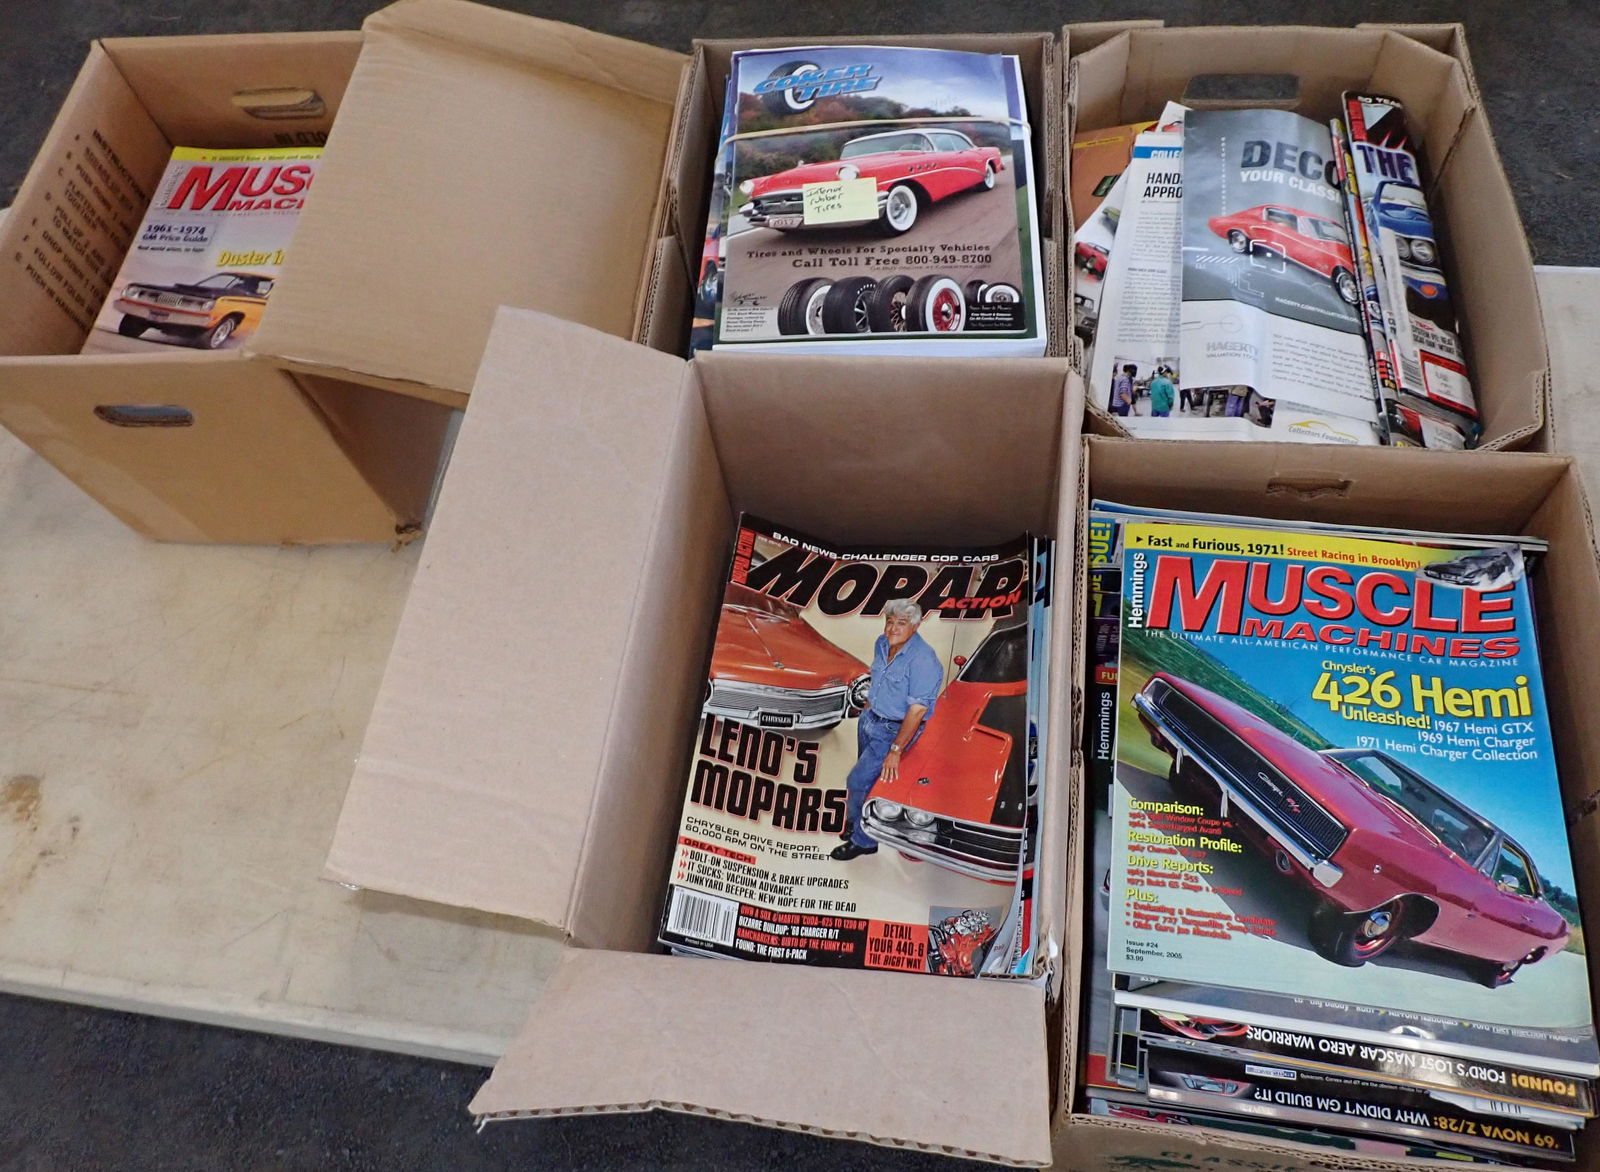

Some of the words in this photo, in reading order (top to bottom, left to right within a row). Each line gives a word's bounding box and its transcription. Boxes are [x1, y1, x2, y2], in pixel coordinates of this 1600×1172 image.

[753, 64, 873, 93] COKER
[798, 77, 882, 101] TIRE
[1151, 150, 1183, 158] COLLE
[1146, 172, 1182, 185] HAND
[1240, 169, 1285, 184] YOUR
[166, 165, 315, 211] MUS
[814, 203, 842, 213] Tires
[183, 235, 208, 243] Guide
[216, 251, 270, 267] Duster
[747, 250, 777, 258] Tires
[781, 248, 803, 256] and
[807, 246, 851, 255] Wheels
[856, 246, 876, 254] For
[880, 245, 935, 255] Specialty
[940, 243, 991, 252] Vehicles
[792, 258, 823, 268] Call
[829, 256, 859, 267] Toll
[865, 256, 900, 266] Free
[905, 254, 992, 265] 800-949-8700
[772, 531, 800, 547] BAD
[930, 554, 959, 562] COP
[963, 554, 999, 562] CARS
[1148, 535, 1173, 548] Fast
[1192, 538, 1245, 555] Furious,
[1247, 542, 1284, 555] 1971!
[1287, 547, 1318, 558] Street
[1321, 549, 1355, 563] Racing
[1358, 553, 1368, 563] in
[1371, 554, 1421, 570] Brooklyn!
[745, 545, 1026, 620] MOPAR
[1128, 552, 1148, 628] Hemmings
[938, 590, 1022, 609] ACTION
[1146, 555, 1516, 635] MUSCLE
[1144, 629, 1165, 638] THE
[1171, 631, 1224, 644] ULTIMATE
[1231, 637, 1318, 651] ALL-AMERICAN
[1325, 644, 1413, 662] PERFORMANCE
[1419, 655, 1441, 665] CAR
[1449, 657, 1519, 668] MAGAZINE
[1243, 618, 1521, 659] MACHINES
[1321, 660, 1377, 676] Chrysler's
[1312, 670, 1402, 711] 426
[1410, 675, 1533, 718] Hemi
[761, 714, 793, 724] CHRYSLER
[1098, 691, 1113, 760] Hemmings
[1341, 704, 1431, 730] Unleashed!
[1434, 720, 1460, 733] 1967
[1464, 722, 1498, 735] Hemi
[1501, 722, 1534, 734] GTX
[699, 712, 820, 784] LENO'S
[1356, 735, 1380, 748] 1971
[1385, 739, 1416, 754] Hemi
[1419, 744, 1468, 762] Charger
[1472, 749, 1538, 762] Collection
[1418, 731, 1444, 743] 1969
[1447, 735, 1480, 747] Hemi
[1484, 736, 1536, 751] Charger
[690, 759, 848, 834] MOPARS
[1128, 797, 1204, 816] Comparison:
[685, 824, 722, 840] 60,000
[725, 835, 747, 848] RPM
[750, 842, 765, 852] ON
[768, 848, 788, 858] THE
[791, 852, 831, 860] STREET
[686, 816, 740, 837] CHRYSLER
[743, 832, 773, 847] DRIVE
[776, 841, 820, 852] REPORT:
[1128, 829, 1196, 848] Restoration
[1200, 836, 1243, 853] Profile:
[684, 837, 720, 854] GREAT
[721, 850, 753, 864] TECH
[722, 859, 770, 881] SUSPENSION
[771, 872, 777, 882] &
[778, 873, 806, 887] BRAKE
[806, 876, 850, 889] UPGRADES
[1127, 853, 1159, 868] Drive
[1162, 857, 1214, 874] Reports:
[687, 861, 695, 872] IT
[696, 863, 724, 880] SUCKS:
[726, 871, 757, 889] VACUUM
[758, 880, 794, 896] ADVANCE
[685, 872, 724, 891] JUNKYARD
[725, 883, 757, 900] BEEPER:
[758, 891, 776, 905] NEW
[777, 896, 799, 908] HOPE
[800, 898, 816, 909] FOR
[819, 899, 834, 911] THE
[835, 901, 857, 913] DEAD
[1126, 887, 1159, 903] Plus:
[738, 915, 763, 930] BIZARRE
[763, 920, 789, 935] BUILDUP:
[800, 927, 828, 939] CHARGER
[828, 929, 840, 939] R/T
[760, 909, 771, 920] SOX
[779, 913, 800, 925] MARTIN
[835, 918, 842, 928] TO
[858, 920, 867, 931] HP
[883, 923, 912, 940] DETAIL
[735, 938, 756, 952] FOUND:
[756, 943, 768, 955] THE
[767, 946, 784, 959] FIRST
[785, 948, 808, 960] 6-PACK
[799, 938, 807, 948] OF
[808, 939, 819, 949] THE
[820, 940, 840, 951] FUNNY
[841, 941, 855, 952] CAR
[869, 937, 893, 953] YOUR
[896, 940, 925, 957] 440-6
[1126, 939, 1144, 947] Issue
[1126, 946, 1164, 958] September,
[869, 953, 881, 965] THE
[882, 955, 905, 968] RIGHT
[906, 957, 922, 969] WAY
[1126, 954, 1144, 962] $3.99
[1246, 1026, 1315, 1050] WARRIORS
[1318, 1038, 1356, 1056] AERO
[1360, 1045, 1416, 1067] NASCAR
[1420, 1055, 1453, 1074] LOST
[1456, 1063, 1507, 1084] FORD'S
[1254, 1087, 1272, 1101] IT?
[1511, 1072, 1576, 1097] FOUND!
[1275, 1091, 1313, 1108] BUILD
[1316, 1096, 1341, 1112] GM
[1344, 1101, 1392, 1120] DIDN'T
[1395, 1109, 1431, 1127] WHY
[1434, 1115, 1477, 1135] Z/28:
[1480, 1123, 1531, 1145] NOVA
[1534, 1133, 1559, 1149] '69
